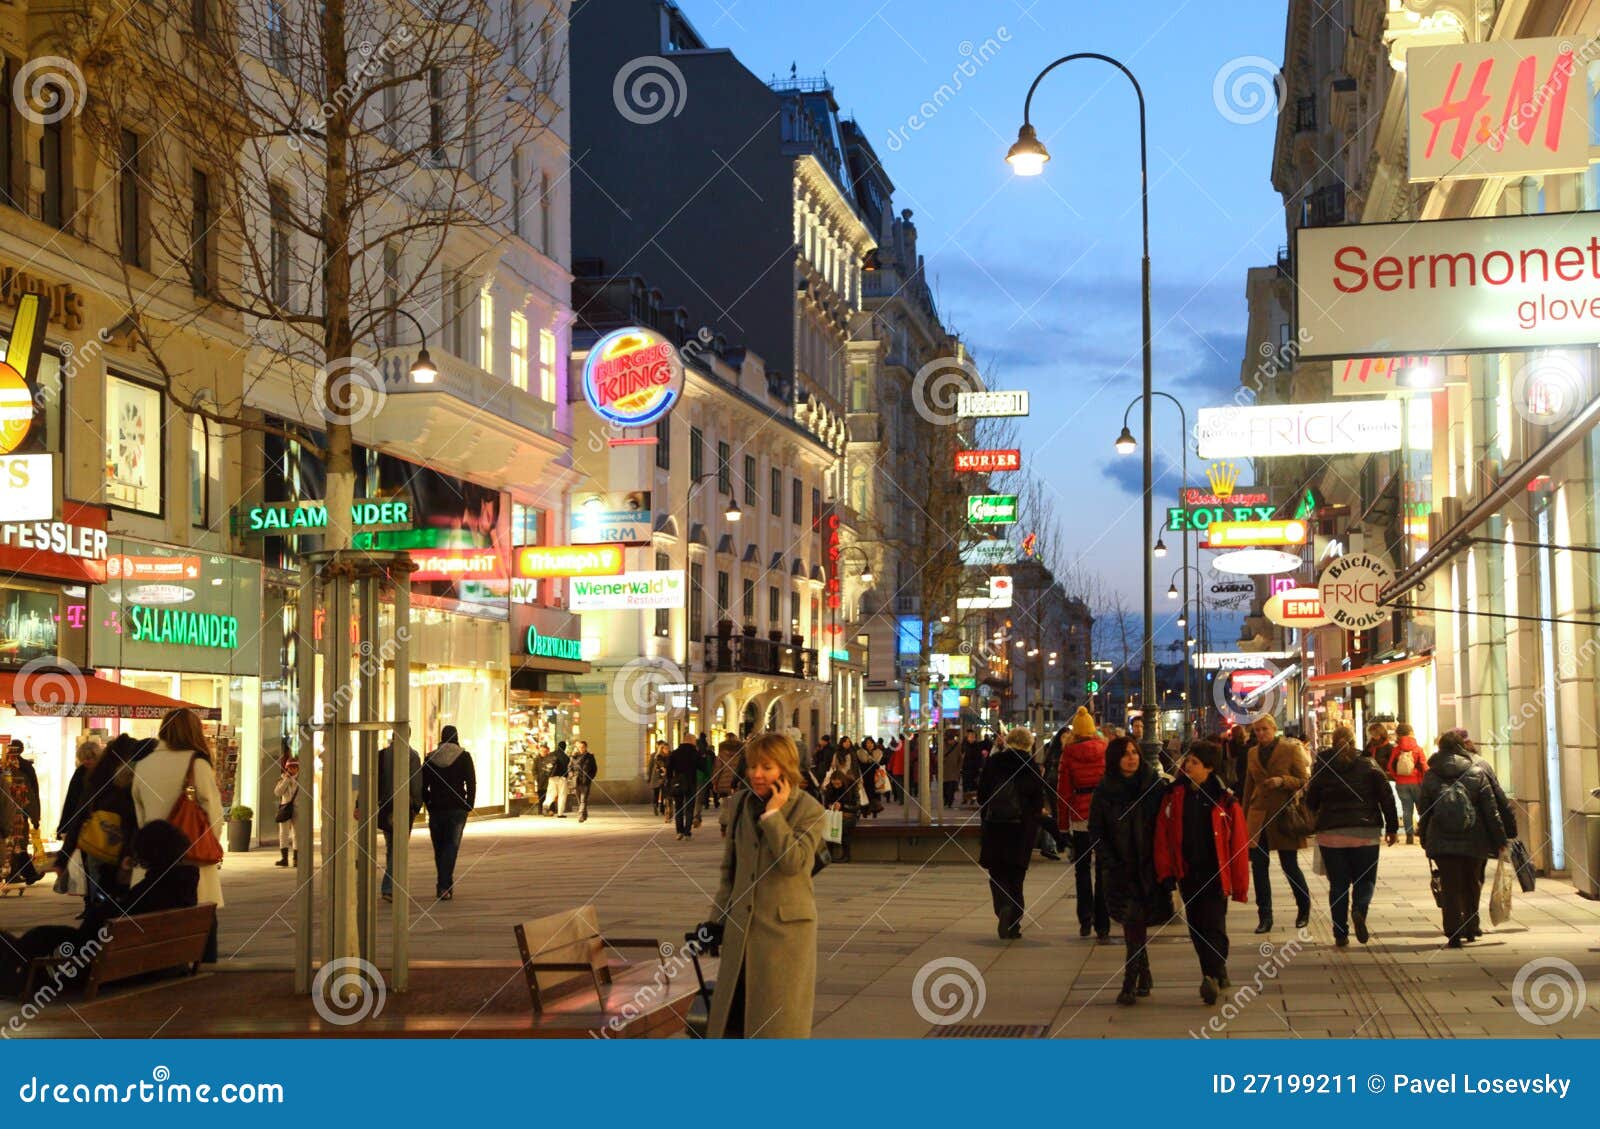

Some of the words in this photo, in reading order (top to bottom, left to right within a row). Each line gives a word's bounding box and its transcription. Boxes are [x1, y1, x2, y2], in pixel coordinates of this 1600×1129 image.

[1421, 50, 1574, 161] H&M
[1332, 236, 1600, 294] Sermonet
[1517, 293, 1600, 330] glove
[594, 342, 670, 383] BURGER
[597, 361, 671, 406] KING
[957, 454, 1017, 468] KURIER
[250, 502, 409, 530] SALAMNDER
[1169, 506, 1276, 530] ROLEX
[527, 552, 598, 573] Triumph
[828, 513, 841, 609] CASINO
[1328, 554, 1388, 579] Bücher
[1286, 602, 1320, 615] EMI
[1334, 608, 1386, 627] Books
[131, 604, 239, 649] SALAMANDER
